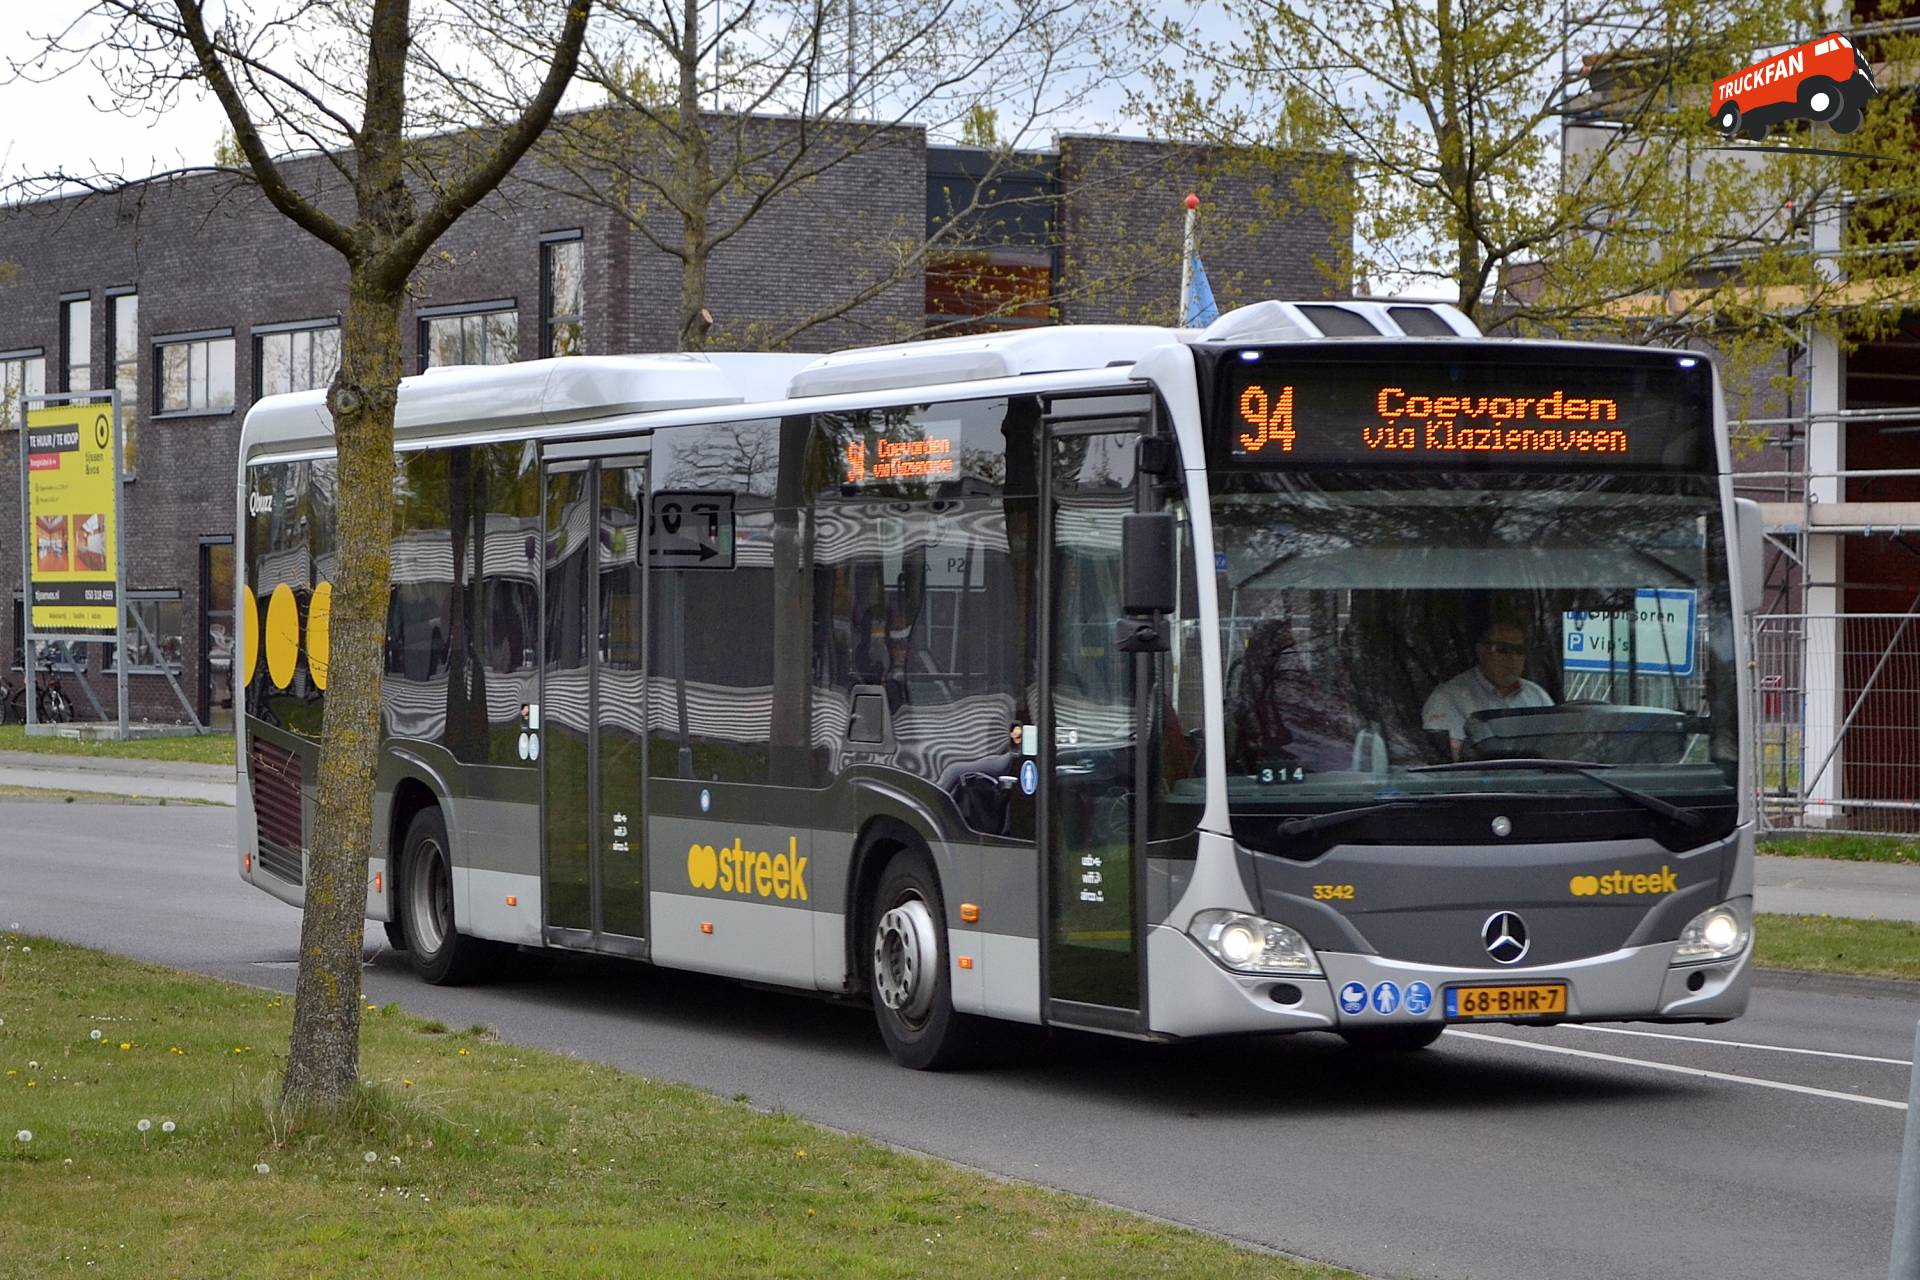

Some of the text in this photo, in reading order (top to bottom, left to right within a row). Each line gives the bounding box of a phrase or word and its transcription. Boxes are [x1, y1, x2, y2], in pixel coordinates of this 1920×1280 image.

[1376, 387, 1618, 421] Coevorden
[1239, 385, 1297, 453] 94
[1363, 419, 1628, 452] via Klazienaveen
[249, 491, 273, 517] Qbuzz
[947, 557, 966, 573] P2
[1262, 767, 1305, 782] 314
[719, 836, 809, 900] streek
[1600, 864, 1678, 896] streek
[1312, 884, 1355, 900] 3342
[1463, 989, 1558, 1012] 68-BHR-7
